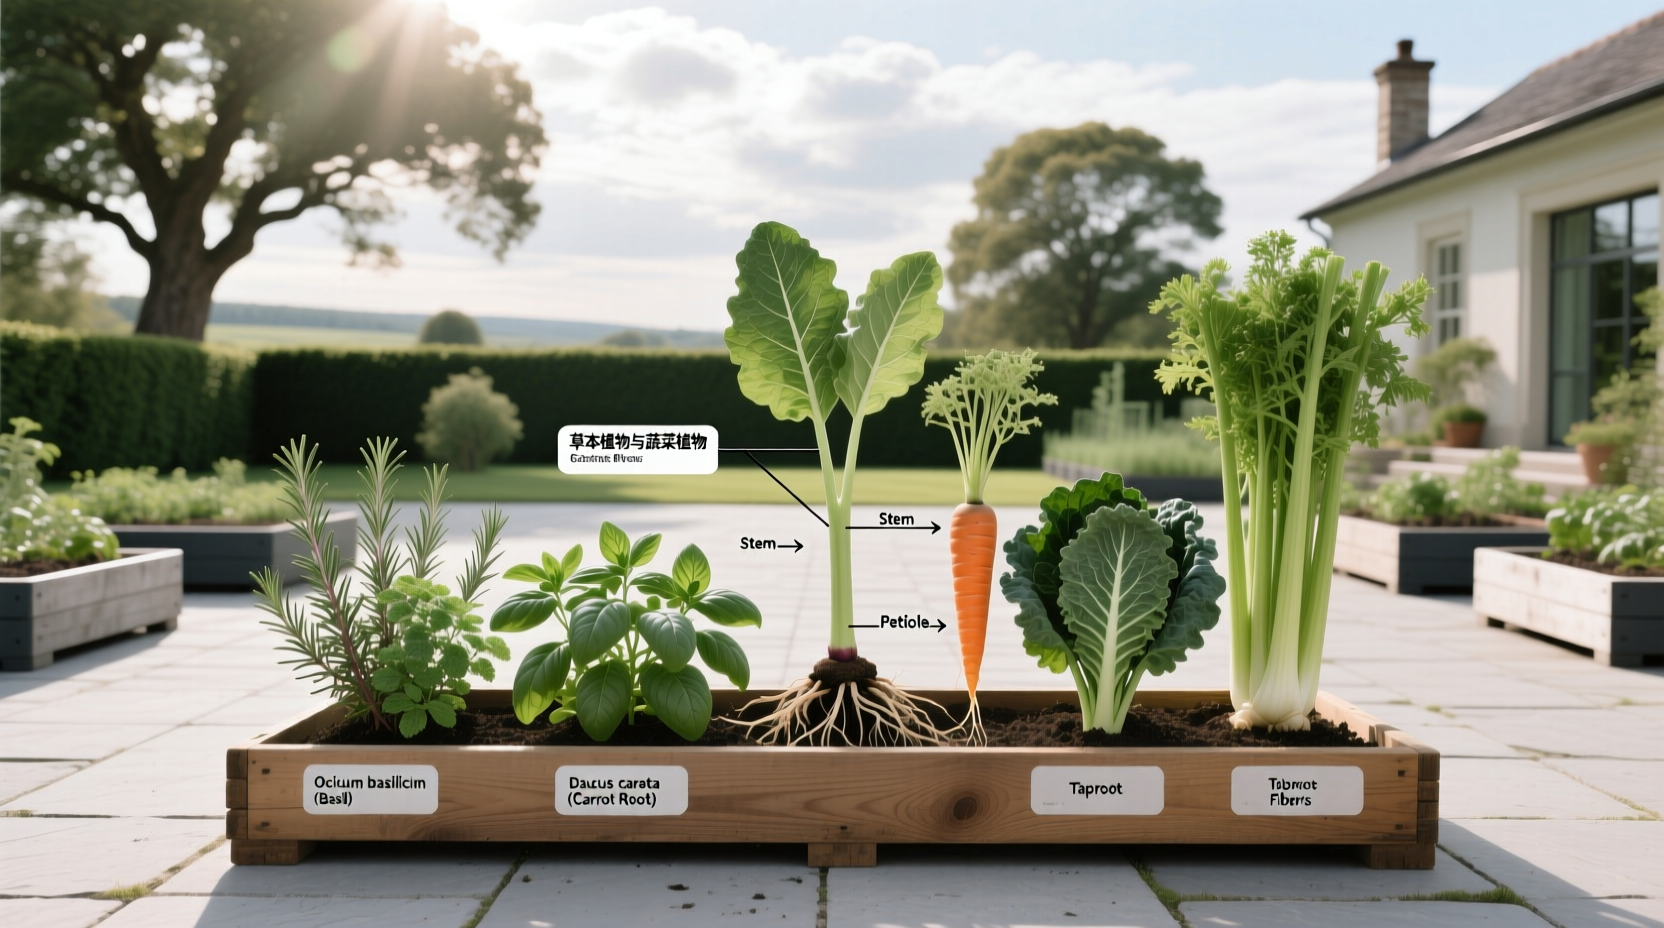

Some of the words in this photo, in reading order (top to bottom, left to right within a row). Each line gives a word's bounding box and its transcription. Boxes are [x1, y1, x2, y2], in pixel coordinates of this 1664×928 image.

[1069, 781, 1123, 799] Taproot
[567, 792, 616, 809] (Carrot
[618, 792, 657, 810] Root)
